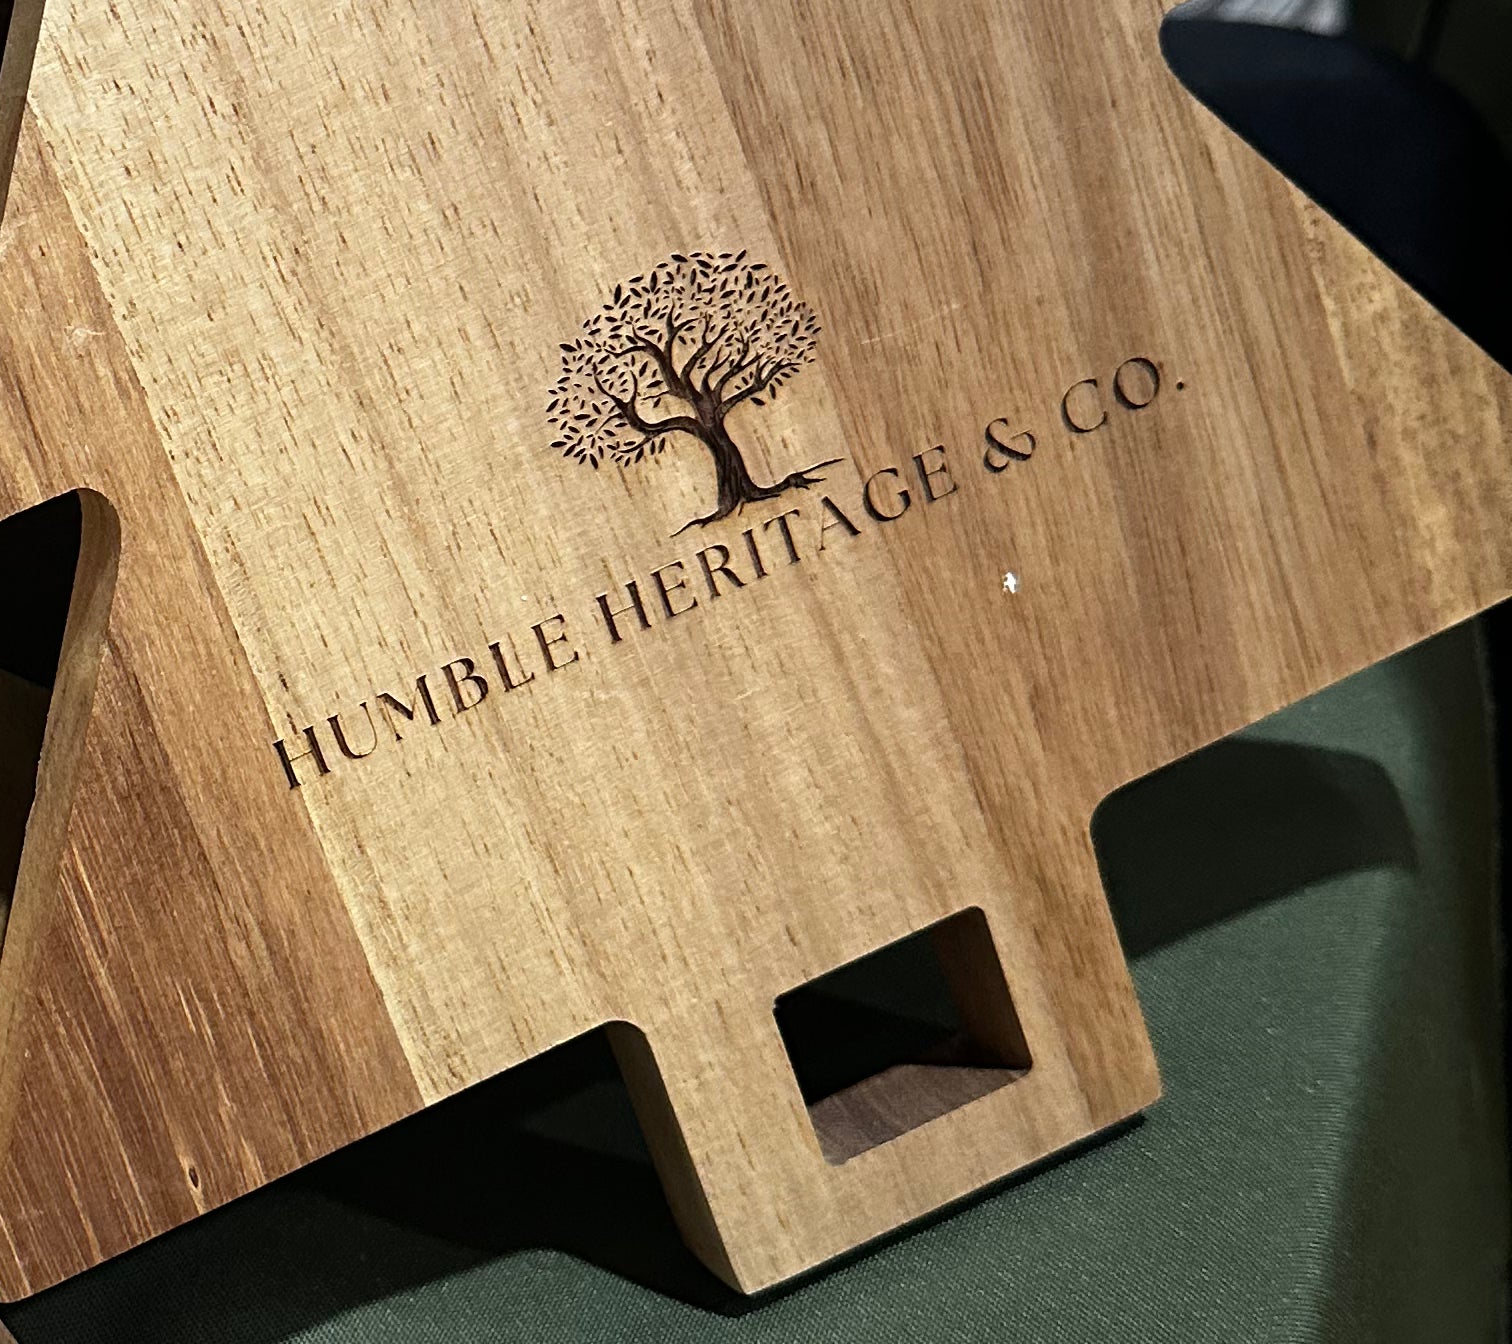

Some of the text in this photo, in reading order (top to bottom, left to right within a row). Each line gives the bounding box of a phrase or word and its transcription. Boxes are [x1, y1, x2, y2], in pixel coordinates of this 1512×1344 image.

[271, 356, 1187, 790] HUMBLE HERITAGE & CO.
